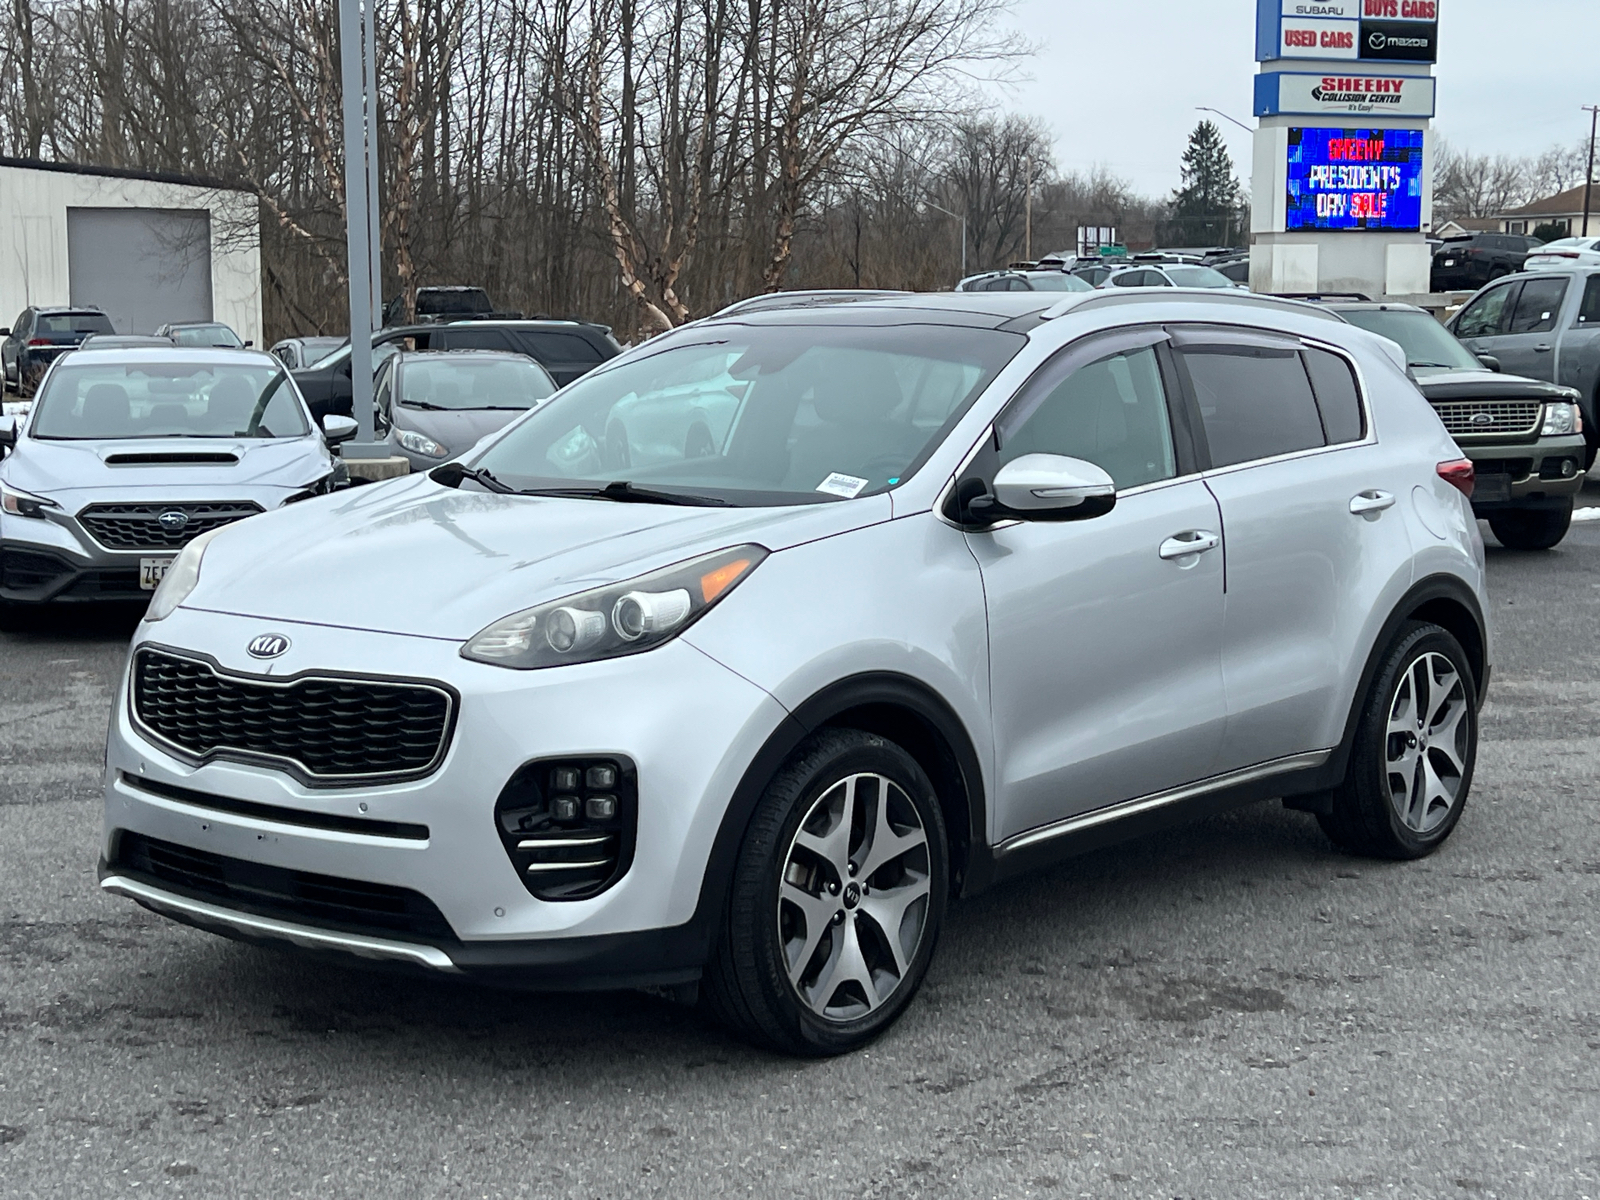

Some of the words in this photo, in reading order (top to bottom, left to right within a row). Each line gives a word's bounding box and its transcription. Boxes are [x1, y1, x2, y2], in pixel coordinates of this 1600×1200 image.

[1296, 5, 1344, 15] SUBARU
[1364, 0, 1398, 17] BUYS
[1401, 0, 1435, 18] CARS
[1284, 30, 1317, 47] USED
[1320, 30, 1354, 48] CARS
[1321, 77, 1404, 93] SHEEHY
[1321, 93, 1368, 103] COLLISION
[1368, 94, 1402, 103] CENTER
[1328, 138, 1384, 160] SHEEHY
[1309, 165, 1401, 190] PRESIDENTS
[1316, 192, 1347, 217] DAY
[1349, 192, 1388, 218] SALE
[250, 636, 282, 654] KIA
